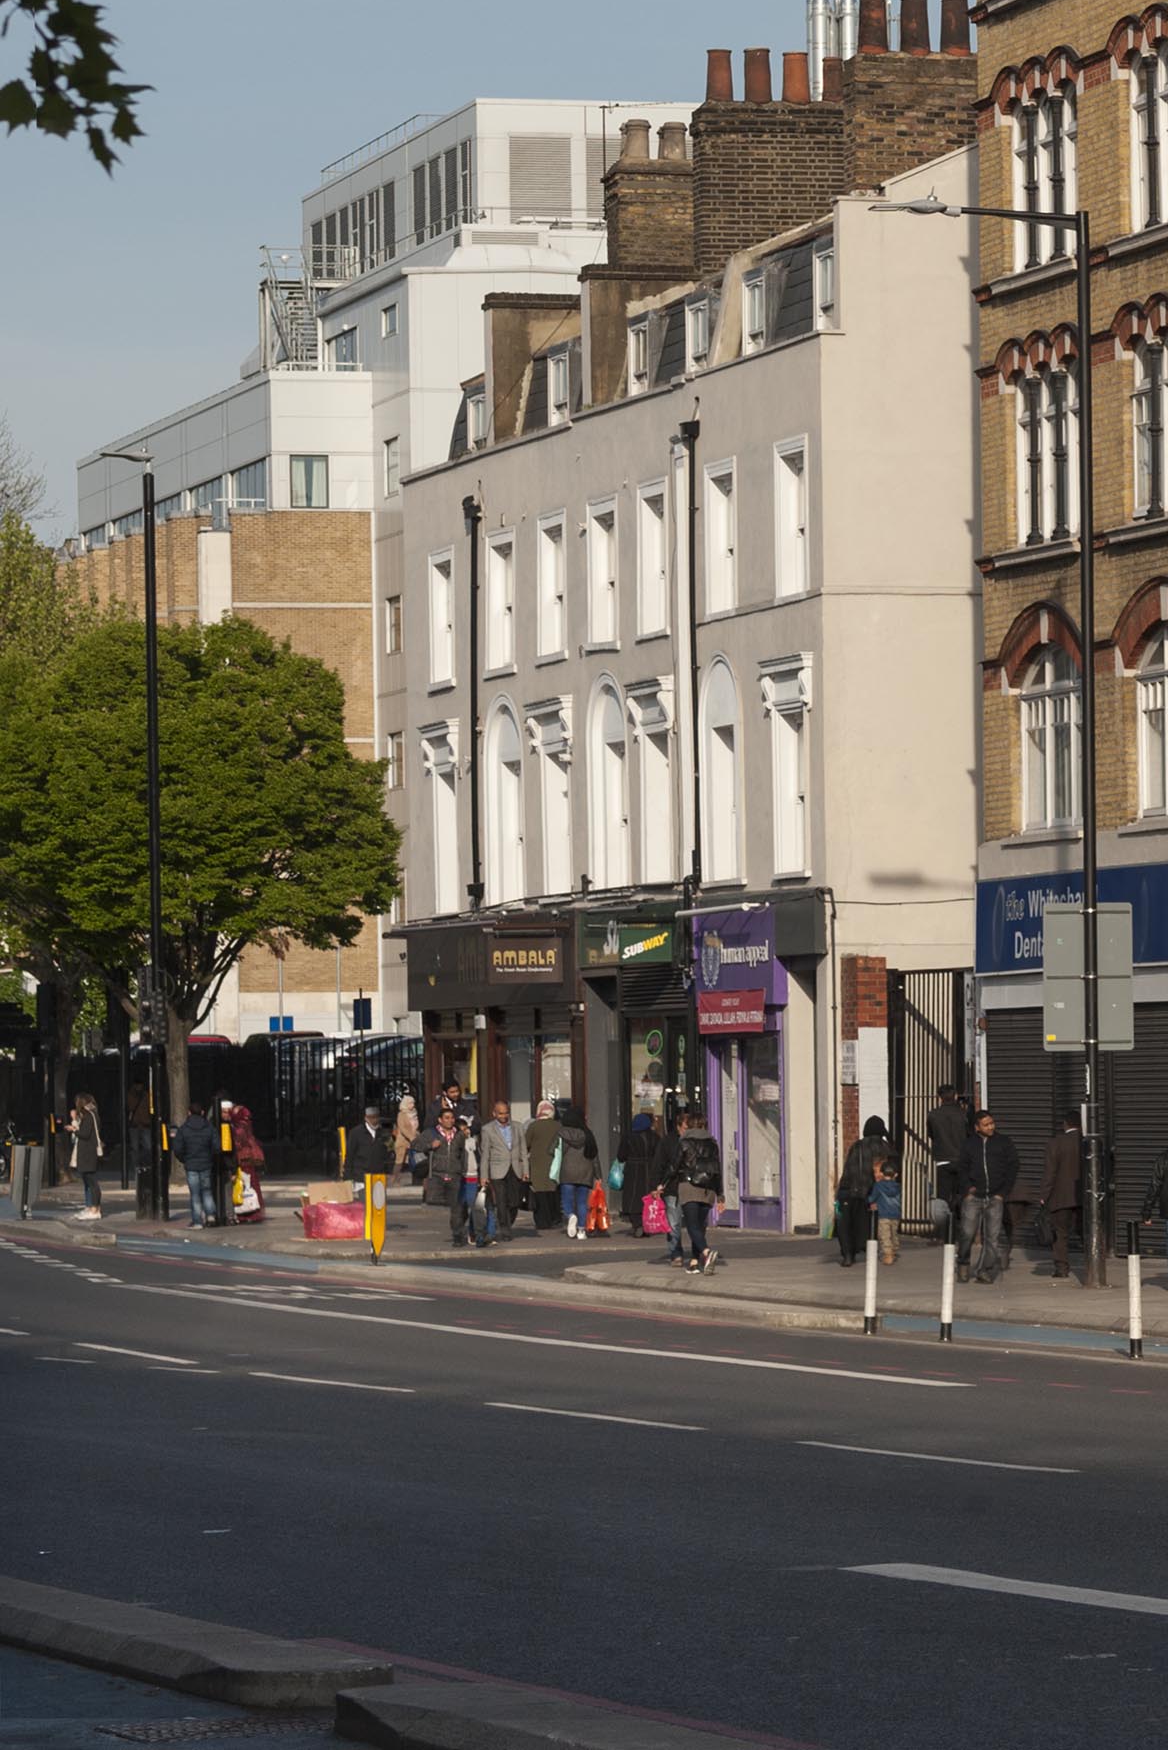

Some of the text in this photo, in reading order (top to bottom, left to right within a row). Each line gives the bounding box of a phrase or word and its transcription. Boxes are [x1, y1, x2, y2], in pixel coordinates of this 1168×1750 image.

[492, 950, 555, 966] AMBALA
[622, 932, 668, 960] SUBWAY
[720, 939, 769, 968] human appeal
